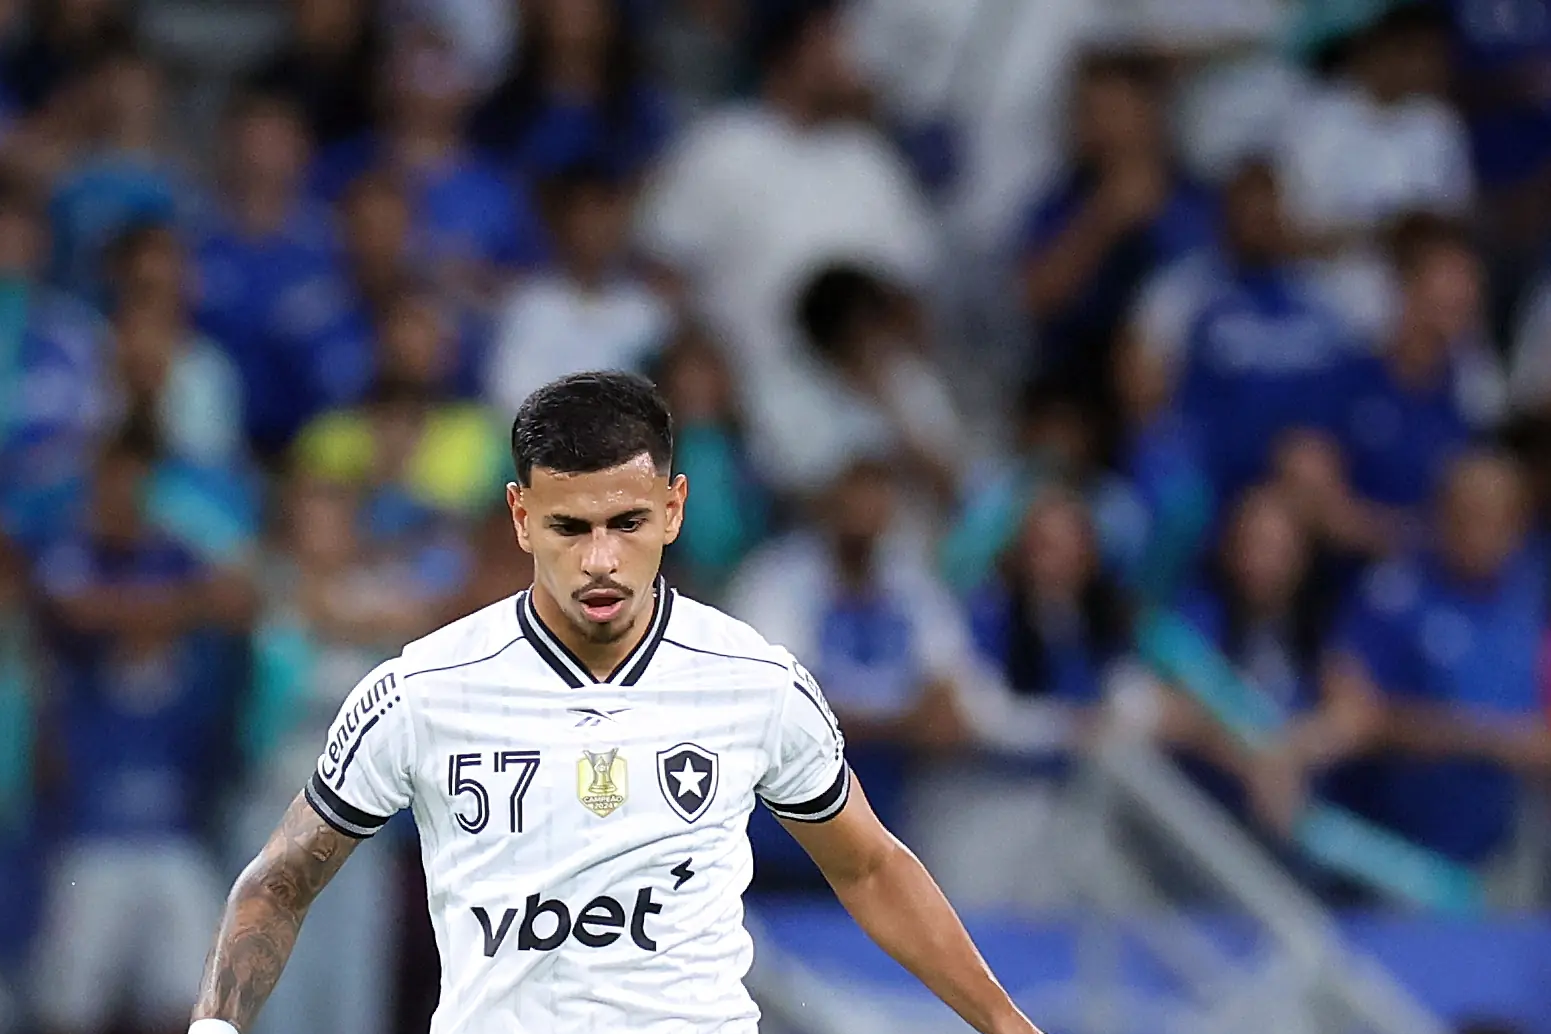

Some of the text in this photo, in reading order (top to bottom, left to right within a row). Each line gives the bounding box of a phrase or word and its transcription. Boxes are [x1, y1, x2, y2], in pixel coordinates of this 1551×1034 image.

[322, 672, 397, 780] Centrum
[448, 750, 541, 834] 57
[470, 887, 663, 958] vbet
